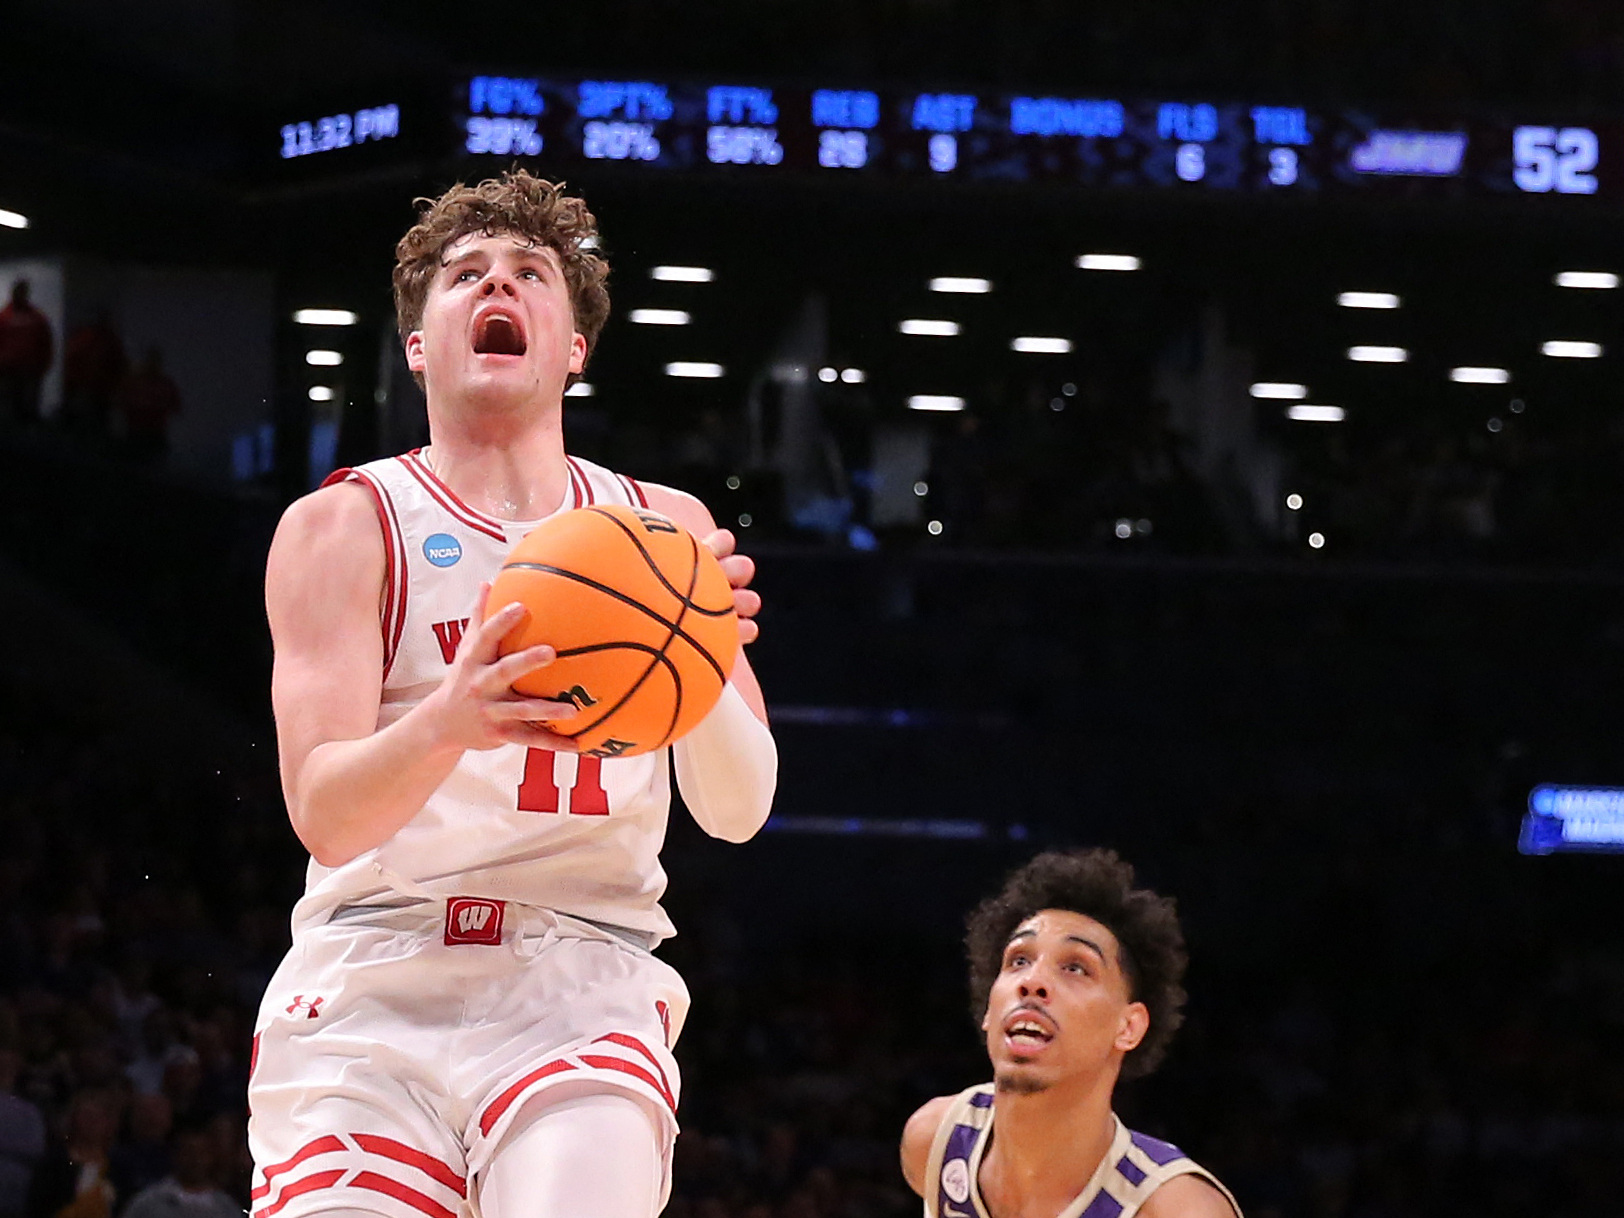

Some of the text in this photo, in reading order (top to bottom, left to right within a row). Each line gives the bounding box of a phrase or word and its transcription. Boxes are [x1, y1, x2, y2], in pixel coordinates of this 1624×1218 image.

[471, 76, 544, 114] FG%
[706, 86, 778, 124] FT%
[353, 104, 399, 143] PM
[1268, 148, 1298, 185] 3
[1513, 126, 1598, 194] 52
[429, 547, 460, 559] NCAA
[517, 747, 609, 815] 11
[458, 905, 493, 934] W
